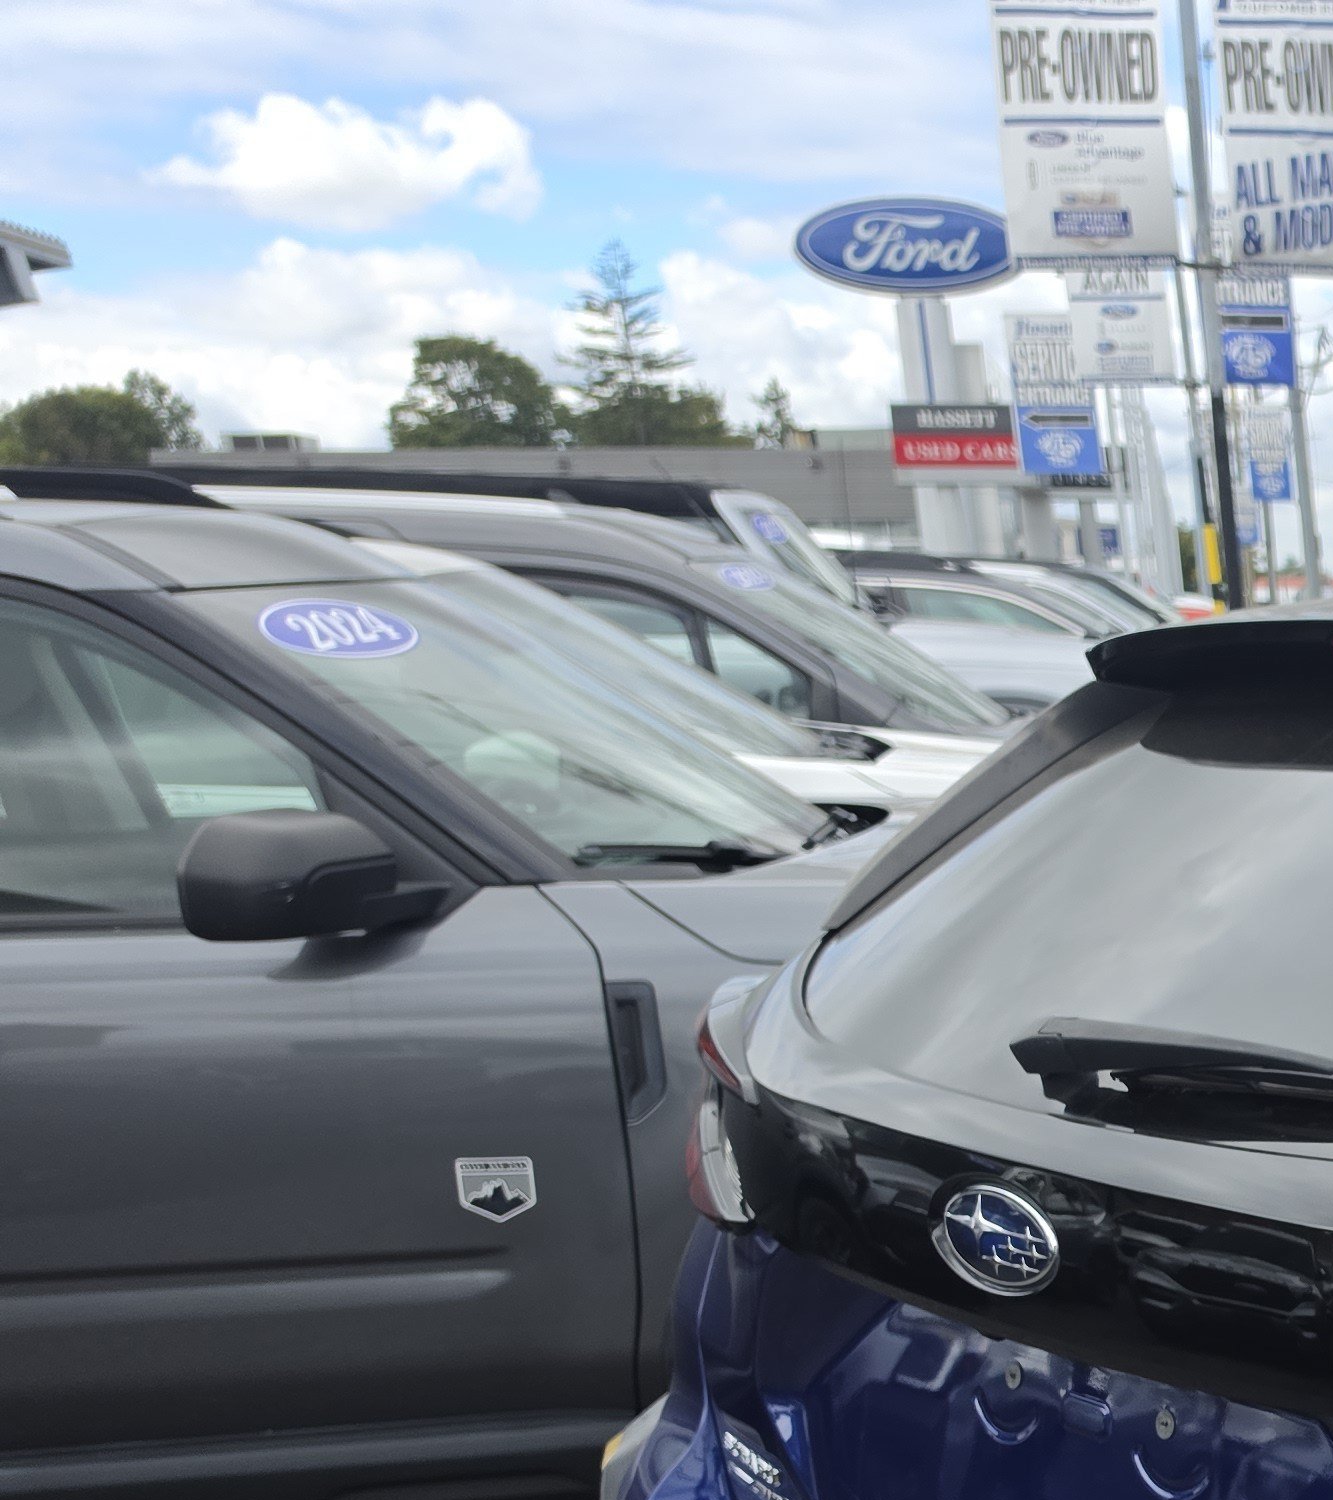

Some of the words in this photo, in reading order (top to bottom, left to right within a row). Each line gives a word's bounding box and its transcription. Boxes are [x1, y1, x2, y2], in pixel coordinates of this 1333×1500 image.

[999, 28, 1159, 104] PRE-OWNED
[1237, 160, 1281, 210] ALL
[842, 211, 980, 272] Ford
[1243, 214, 1262, 256] &
[916, 408, 998, 429] HASSETT
[903, 442, 961, 461] USED
[284, 606, 401, 651] 2024
